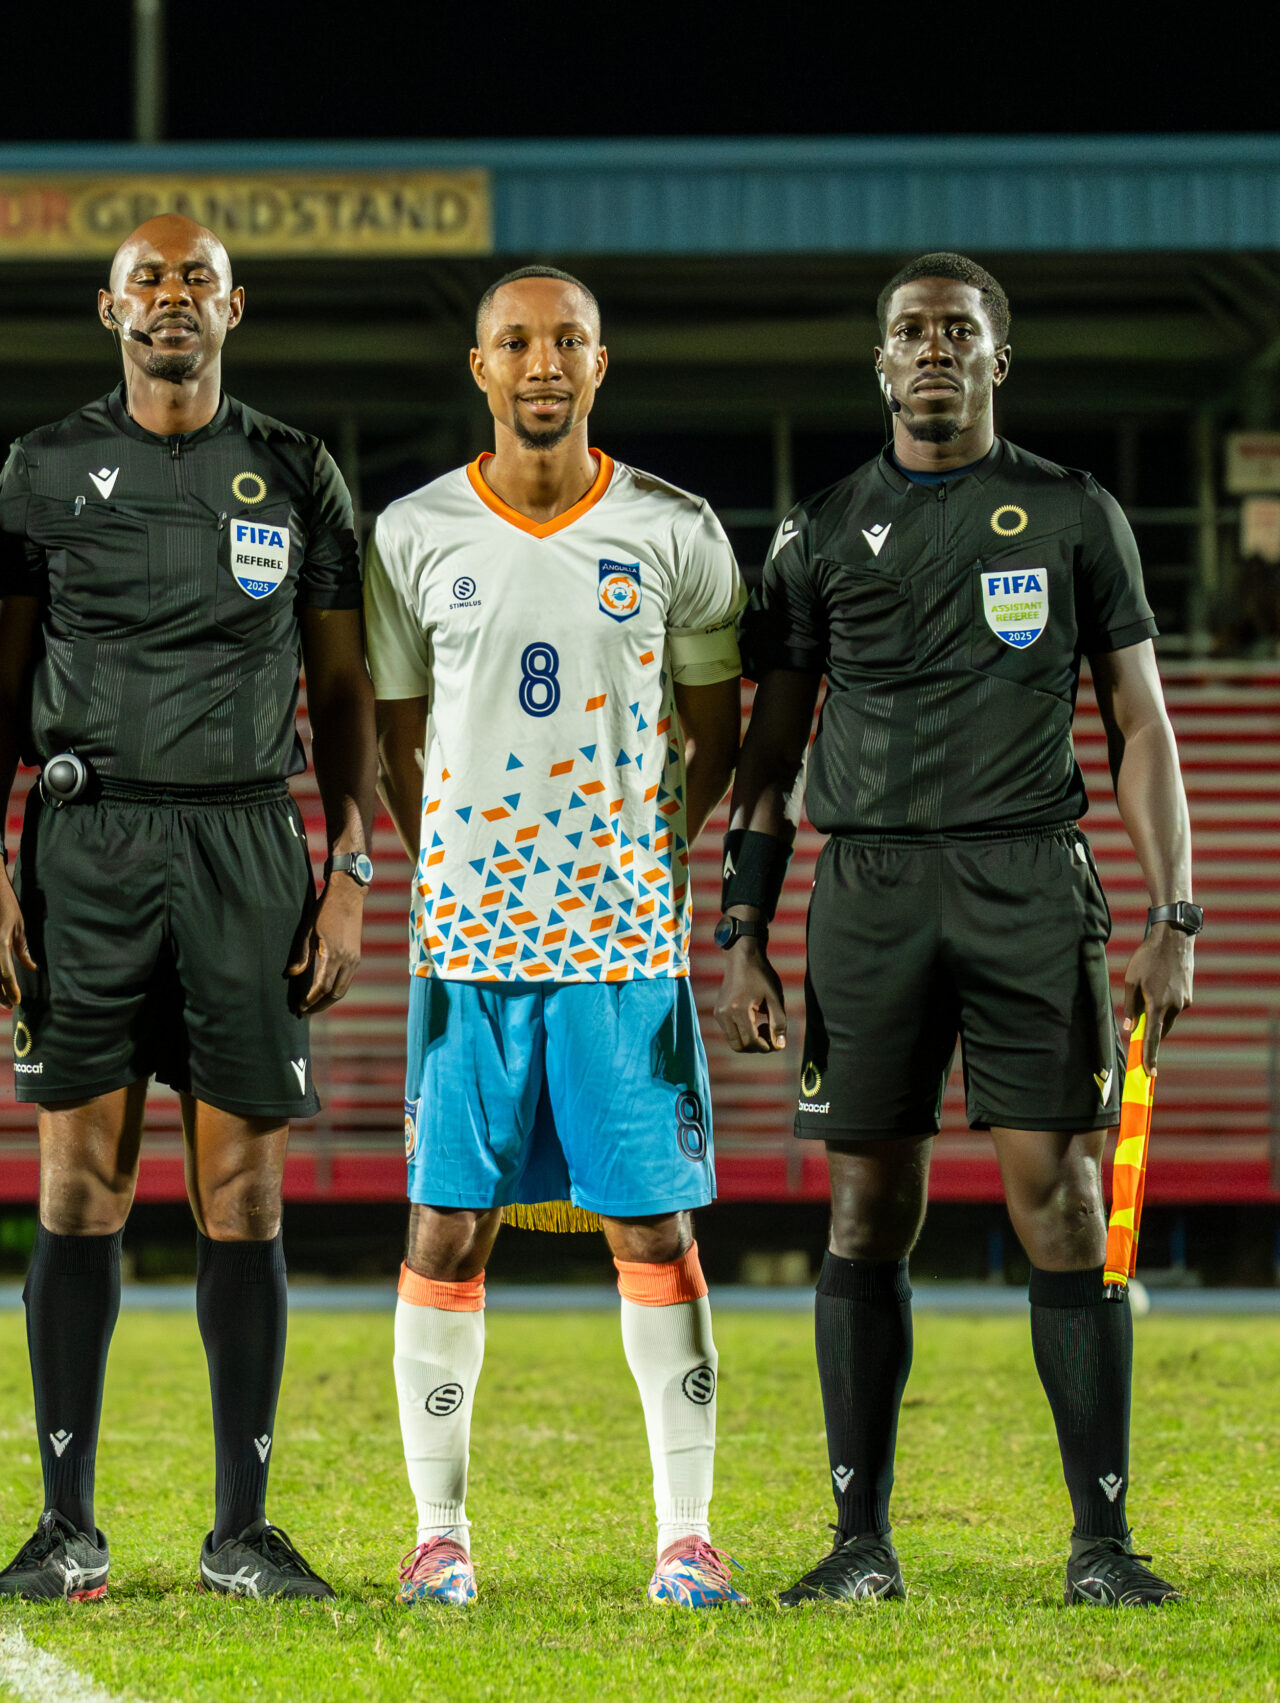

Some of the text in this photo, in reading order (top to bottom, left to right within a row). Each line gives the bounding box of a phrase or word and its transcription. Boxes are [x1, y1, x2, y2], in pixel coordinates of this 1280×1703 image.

[236, 524, 284, 549] FIFA
[236, 553, 283, 570] REFEREE
[246, 581, 269, 592] 2025
[988, 574, 1043, 597] FIFA
[449, 600, 482, 610] STIMULUS
[991, 601, 1042, 613] ASSISTANT
[995, 610, 1040, 622] REFEREE
[1008, 631, 1032, 641] 2025
[519, 641, 561, 718] 8
[675, 1090, 706, 1162] 8
